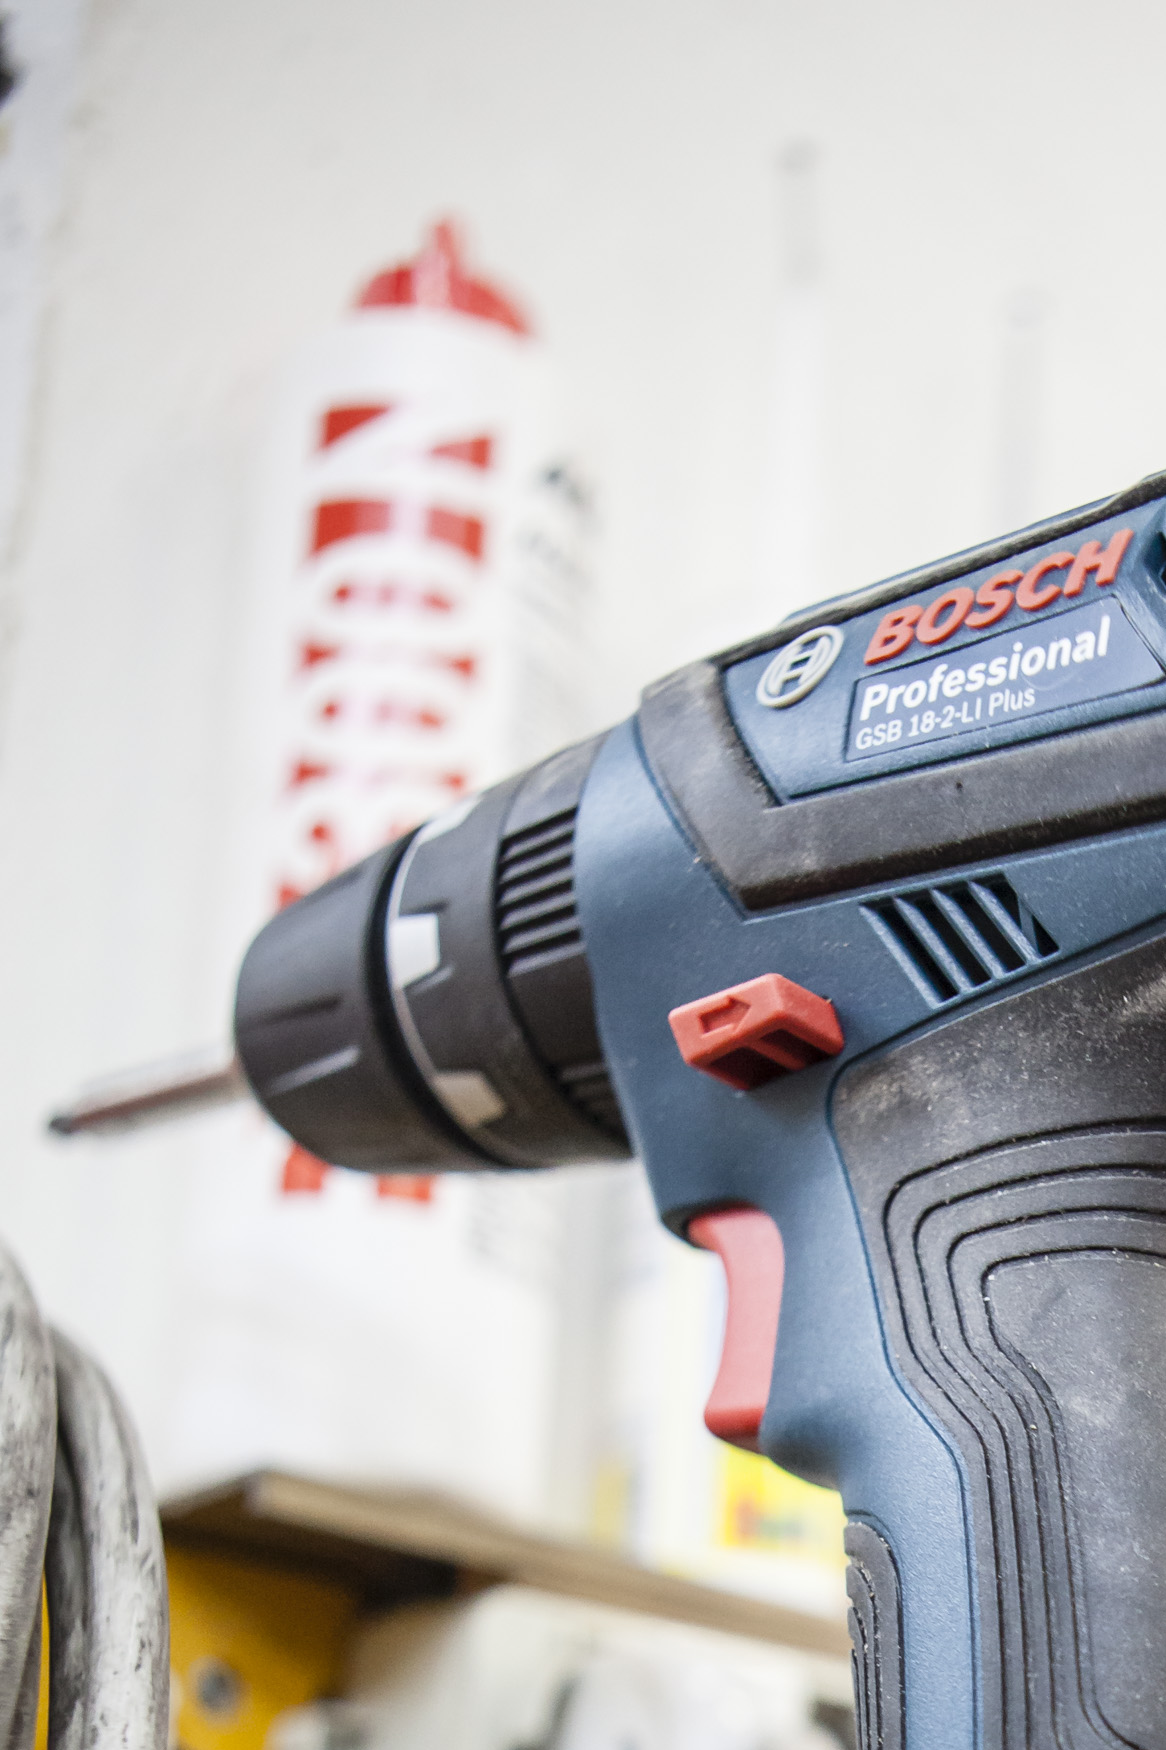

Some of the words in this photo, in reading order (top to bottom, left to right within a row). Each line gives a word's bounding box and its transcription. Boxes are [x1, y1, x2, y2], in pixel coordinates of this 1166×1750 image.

[864, 528, 1134, 665] BOSCH
[855, 718, 902, 750] GSB
[908, 697, 982, 737] 18-2-LI
[988, 687, 1036, 717] Plus
[858, 614, 1110, 721] Professional
